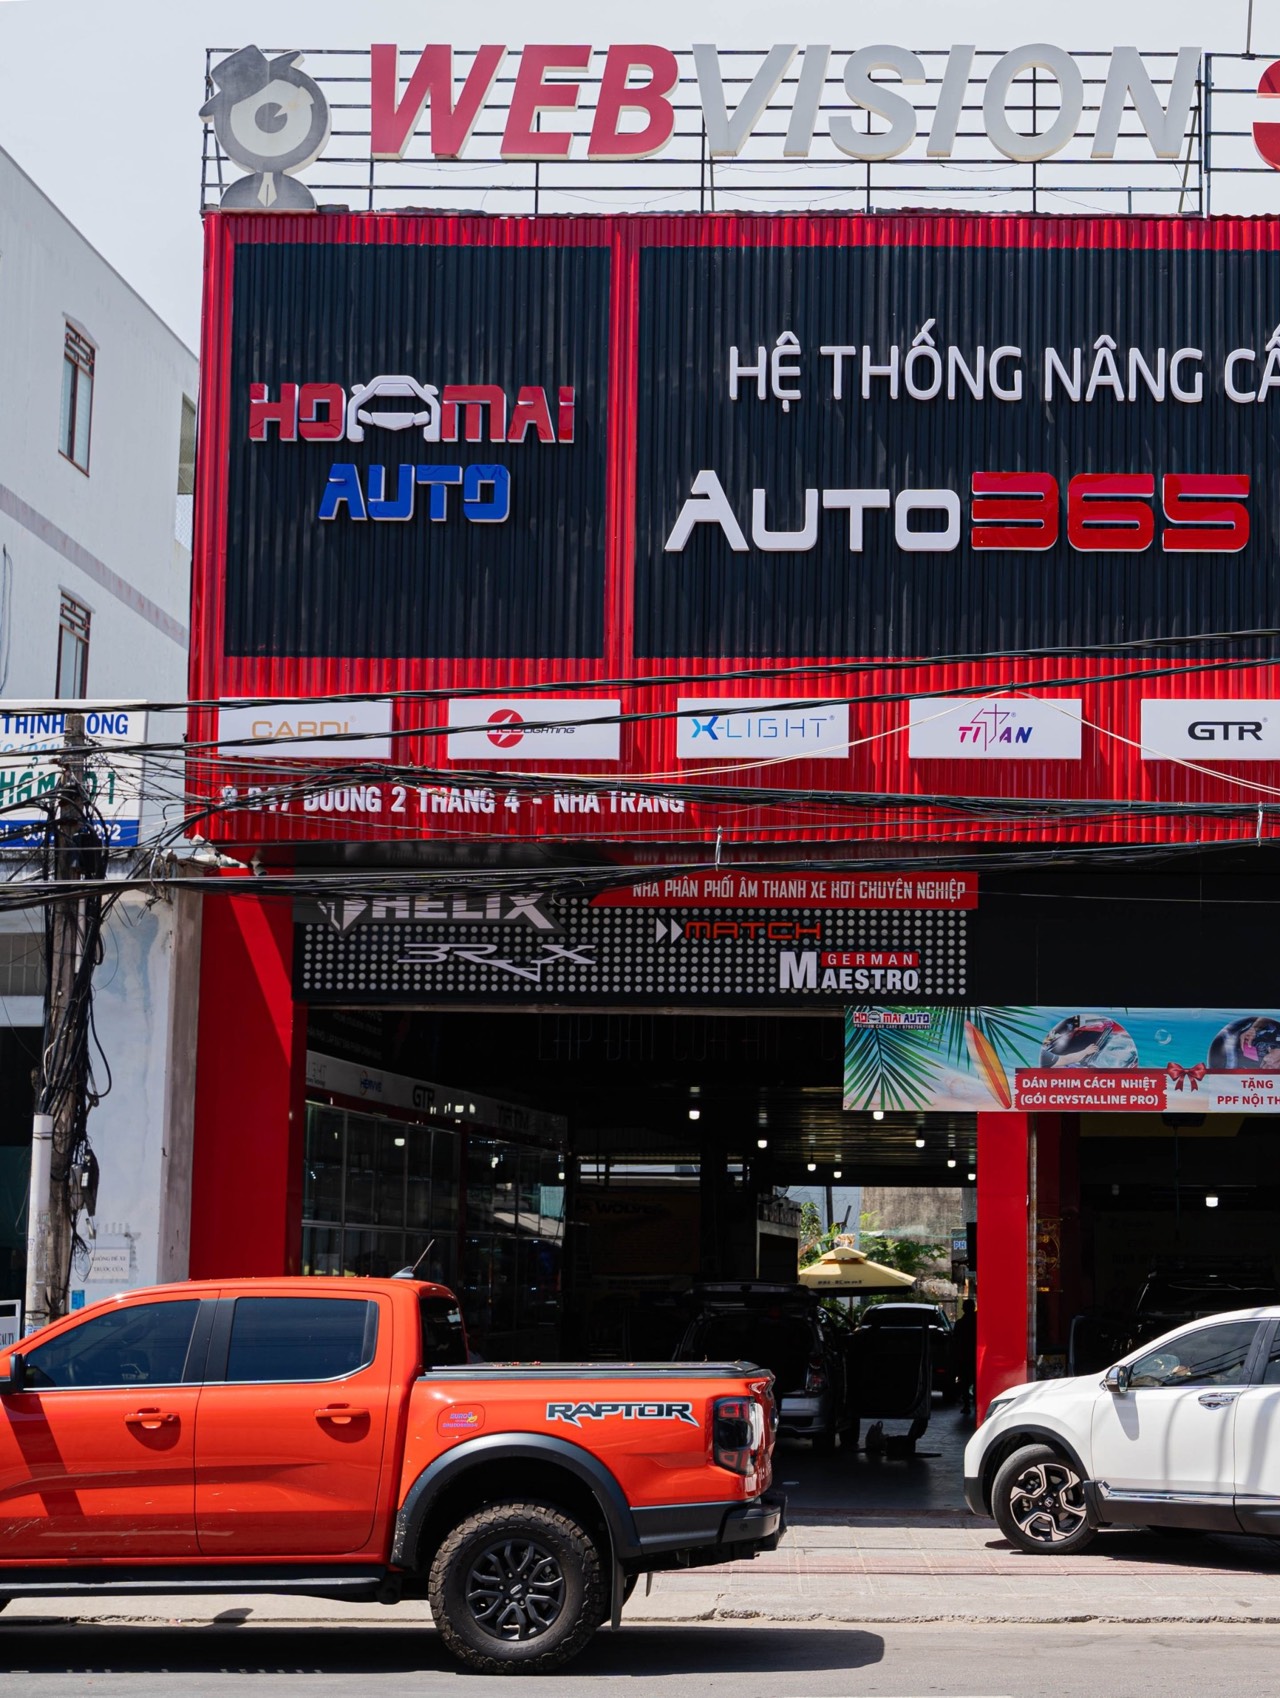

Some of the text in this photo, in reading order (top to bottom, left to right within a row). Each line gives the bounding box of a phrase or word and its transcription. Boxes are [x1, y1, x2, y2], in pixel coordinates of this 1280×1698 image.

[729, 331, 802, 413] HỆ
[819, 318, 1024, 401] THỐNG
[1044, 334, 1204, 404] NÂNG
[318, 464, 511, 523] AUTO
[1187, 721, 1264, 741] GTR
[390, 786, 407, 813] 2
[503, 787, 520, 813] 4
[553, 789, 601, 813] NHA
[610, 790, 685, 813] TRANG
[664, 876, 699, 898] PHÂN
[704, 874, 734, 898] PHỐI
[738, 877, 758, 898] ÂM
[762, 880, 807, 899] THANH
[810, 881, 827, 899] XE
[859, 878, 913, 899] CHUYÊN
[917, 878, 966, 903] NGHIỆP
[683, 920, 822, 941] MATCH
[827, 953, 914, 966] GERMAN
[779, 951, 919, 991] MAESTRO
[903, 1013, 930, 1023] AUTO
[1021, 1074, 1157, 1090] DÁN PHIM CÁCH NHIỆT
[1240, 1078, 1274, 1092] TẶNG
[1020, 1092, 1159, 1106] (GÓI CRYSTALLINE PRO)
[1217, 1096, 1239, 1105] PPF
[1242, 1092, 1264, 1108] NỘI
[545, 1401, 701, 1428] RAPTOR
